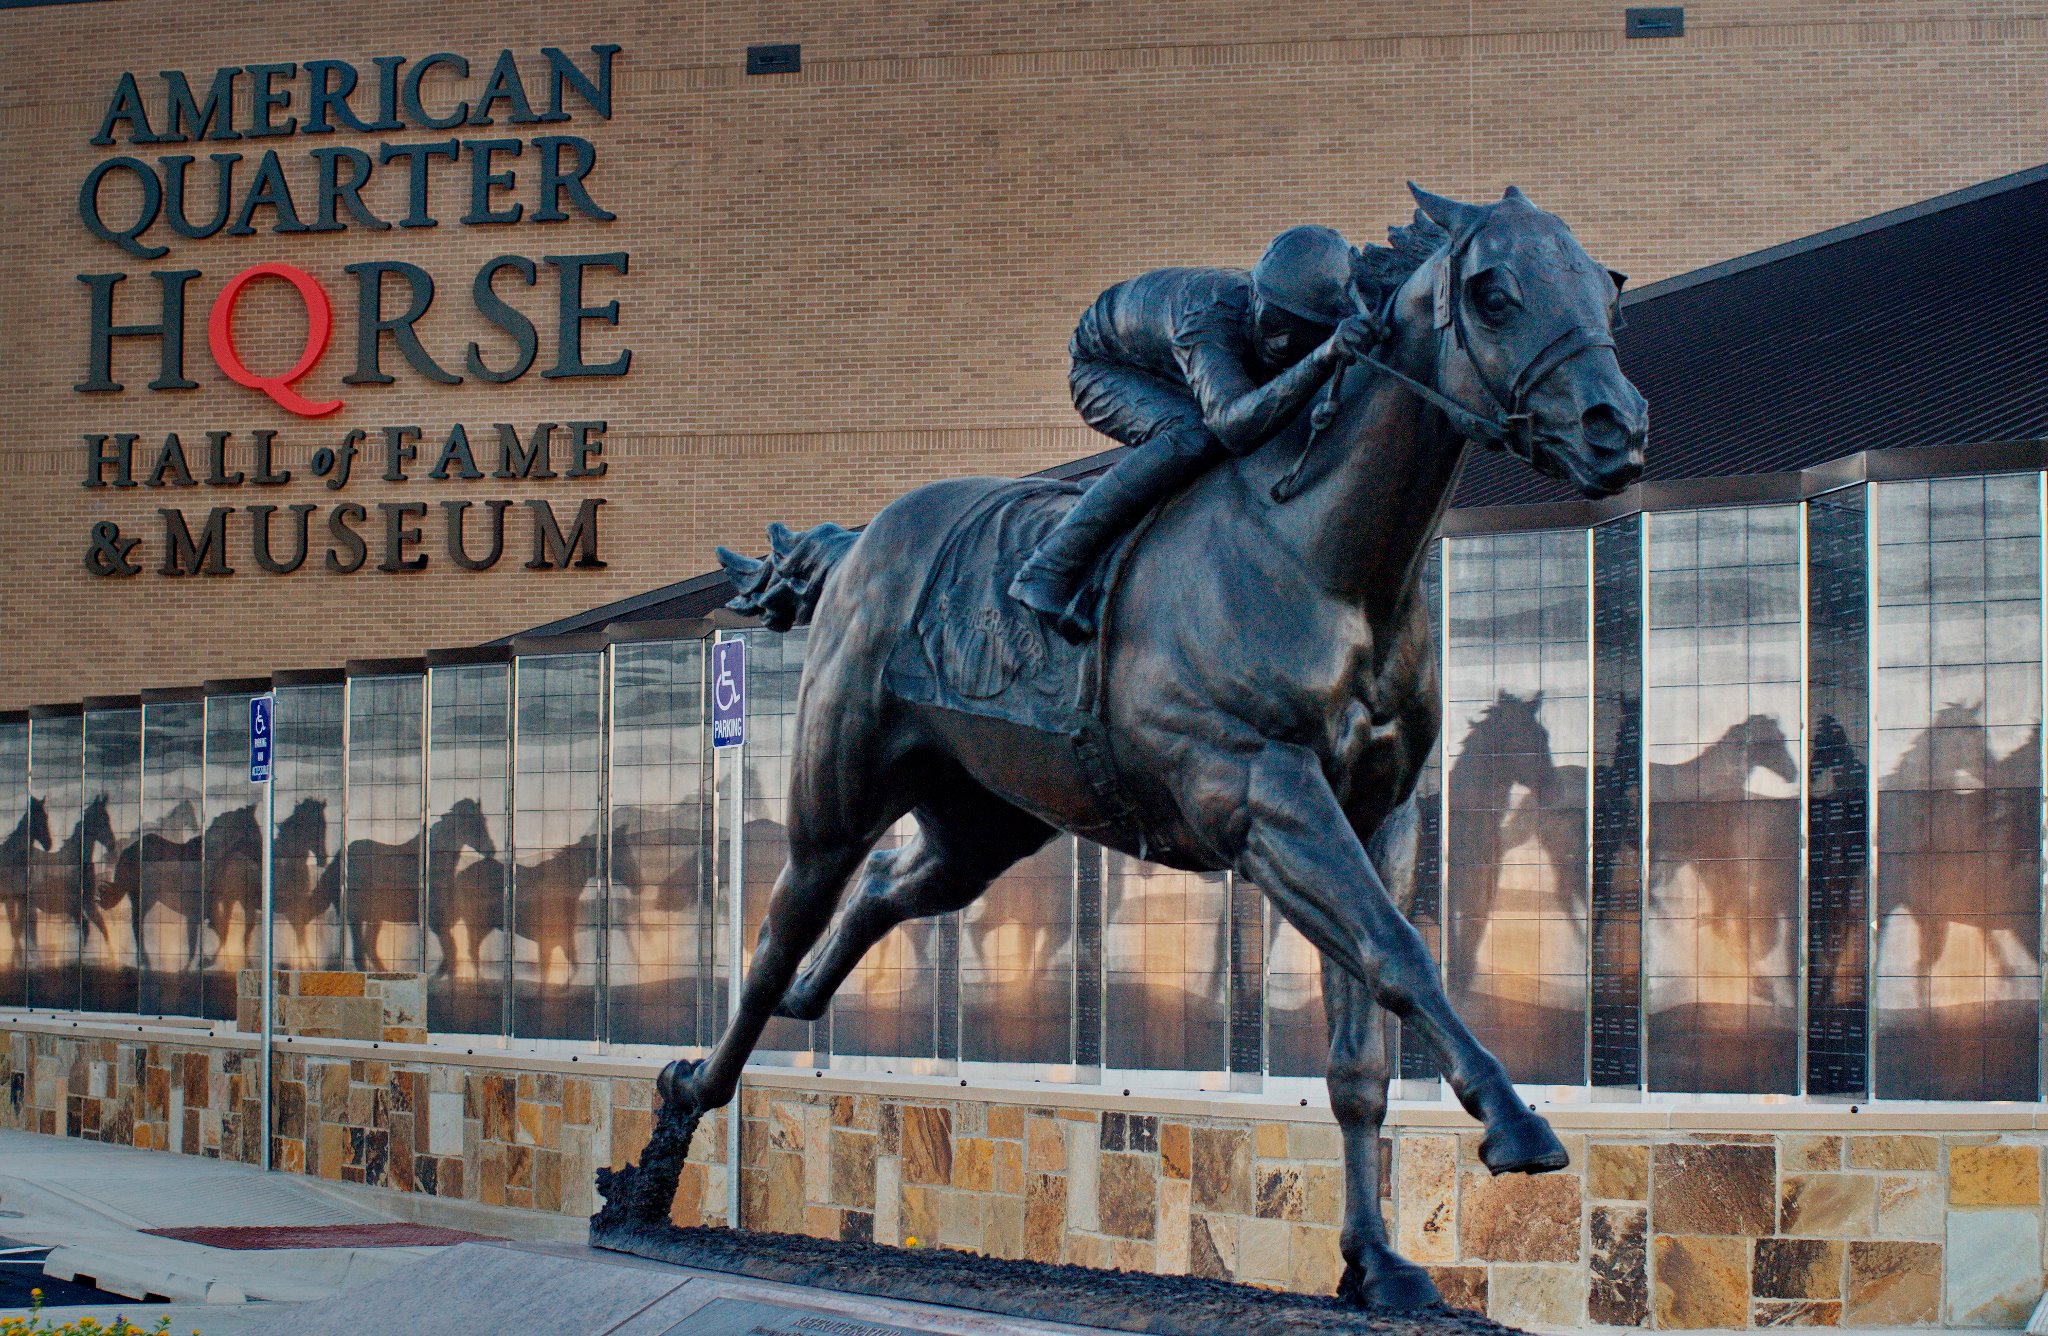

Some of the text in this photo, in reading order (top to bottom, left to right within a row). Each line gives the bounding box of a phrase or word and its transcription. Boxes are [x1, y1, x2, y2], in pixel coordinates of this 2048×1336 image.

[90, 44, 622, 145] AMERICAN
[79, 135, 616, 259] QUARTER
[82, 420, 608, 490] HALL of FAME
[84, 498, 608, 576] & MUSEUM
[714, 717, 742, 738] PARKING
